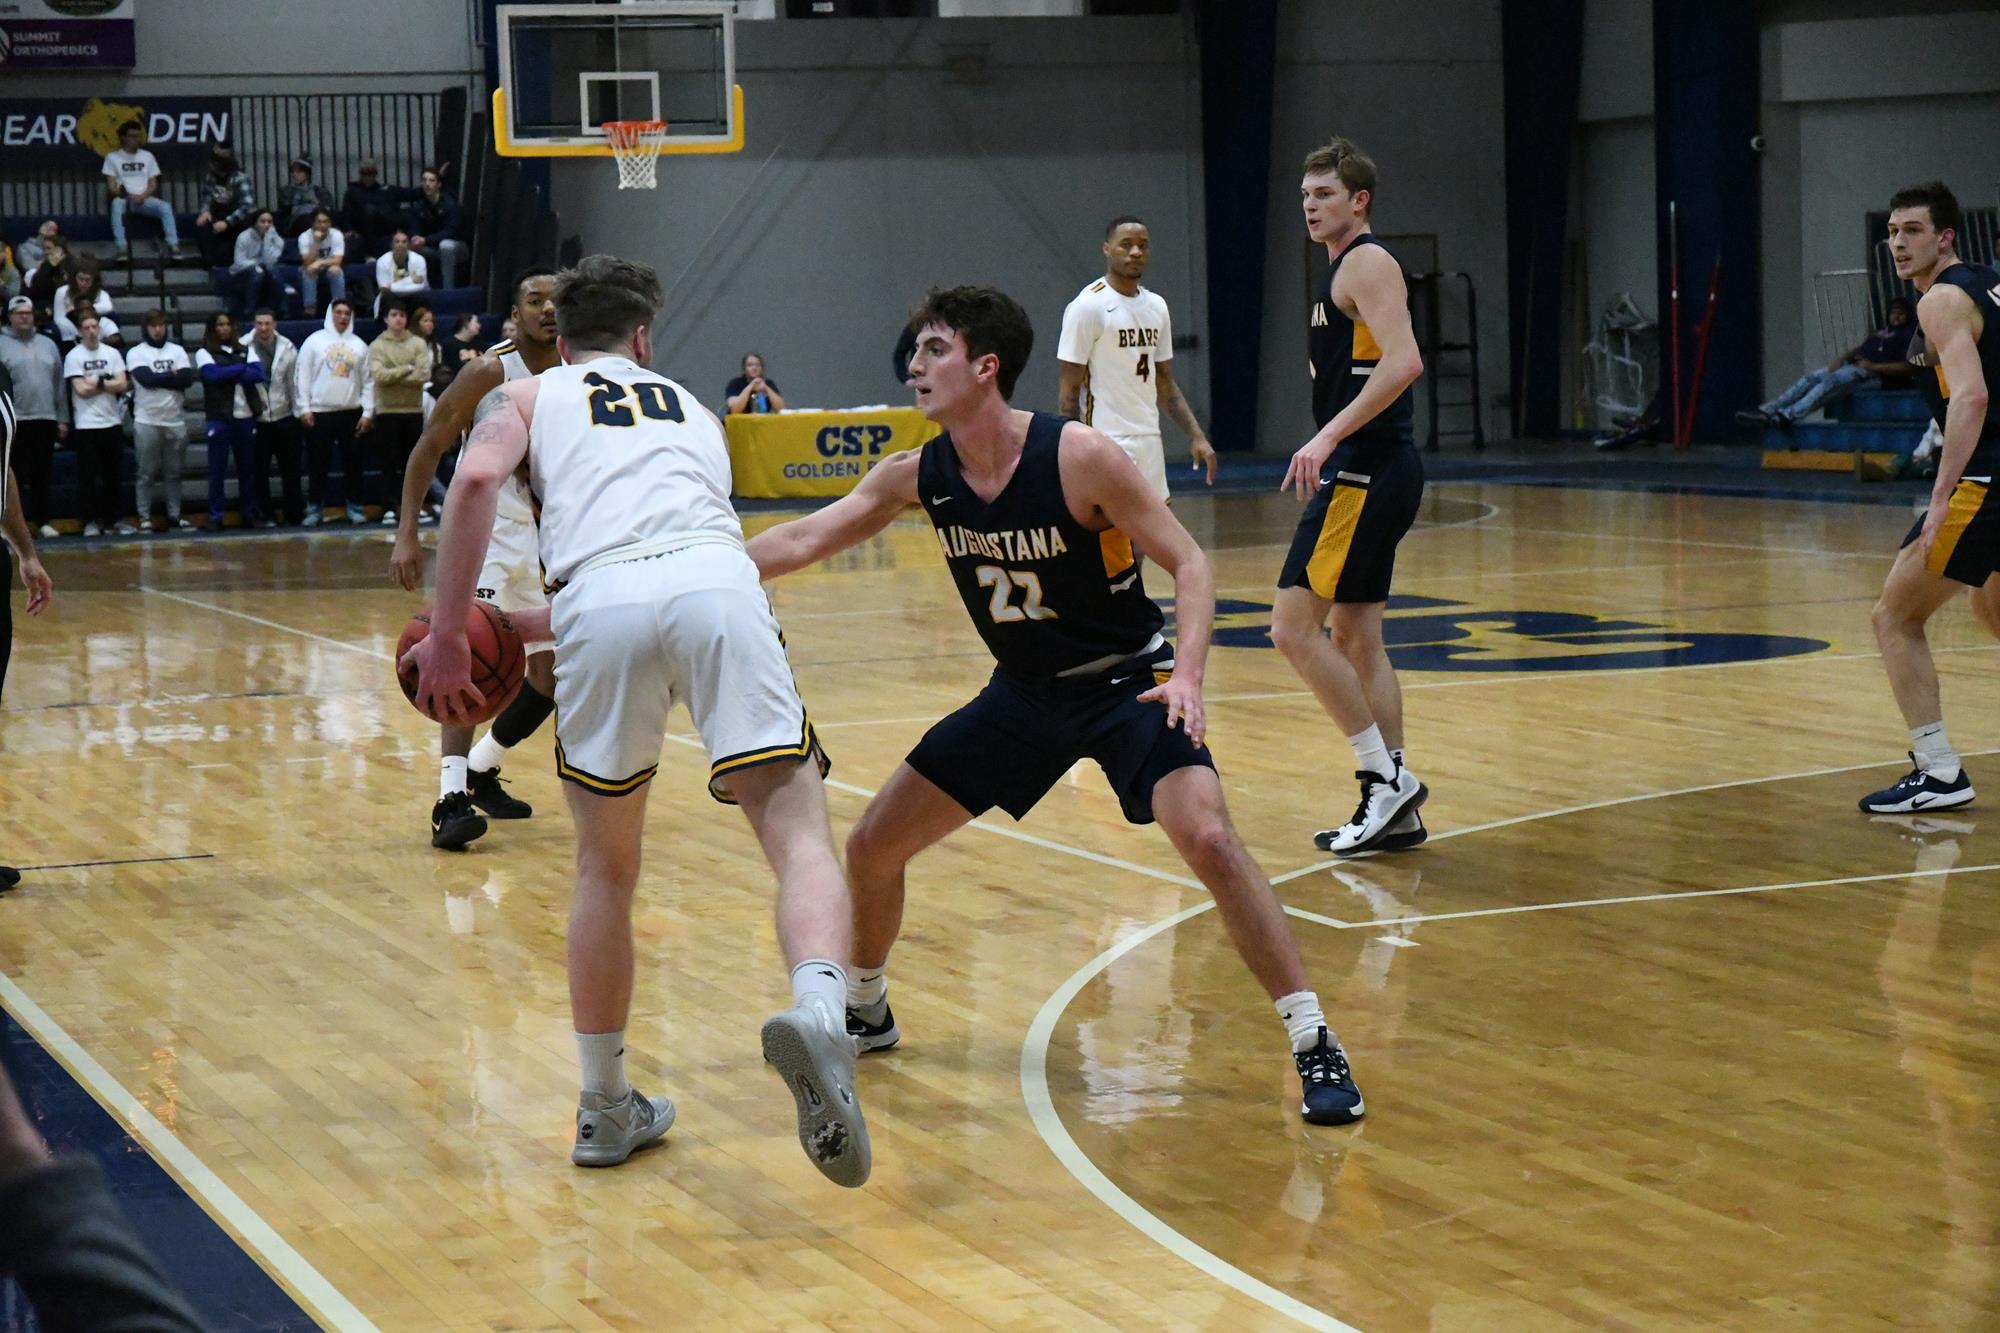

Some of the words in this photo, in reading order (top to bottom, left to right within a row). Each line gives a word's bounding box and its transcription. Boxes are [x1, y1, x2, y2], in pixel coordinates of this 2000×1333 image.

[12, 31, 61, 42] SUMMIT
[12, 44, 99, 56] ORTHOPEDICS
[0, 114, 77, 146] EAR
[147, 112, 229, 144] DEN
[1118, 328, 1159, 348] BEARS
[1135, 353, 1150, 383] 4
[582, 371, 687, 427] 20
[815, 424, 893, 457] CSP
[783, 462, 860, 478] GOLDEN
[937, 525, 1068, 561] AUGUSTANA
[474, 588, 496, 599] SP
[975, 564, 1060, 624] 22
